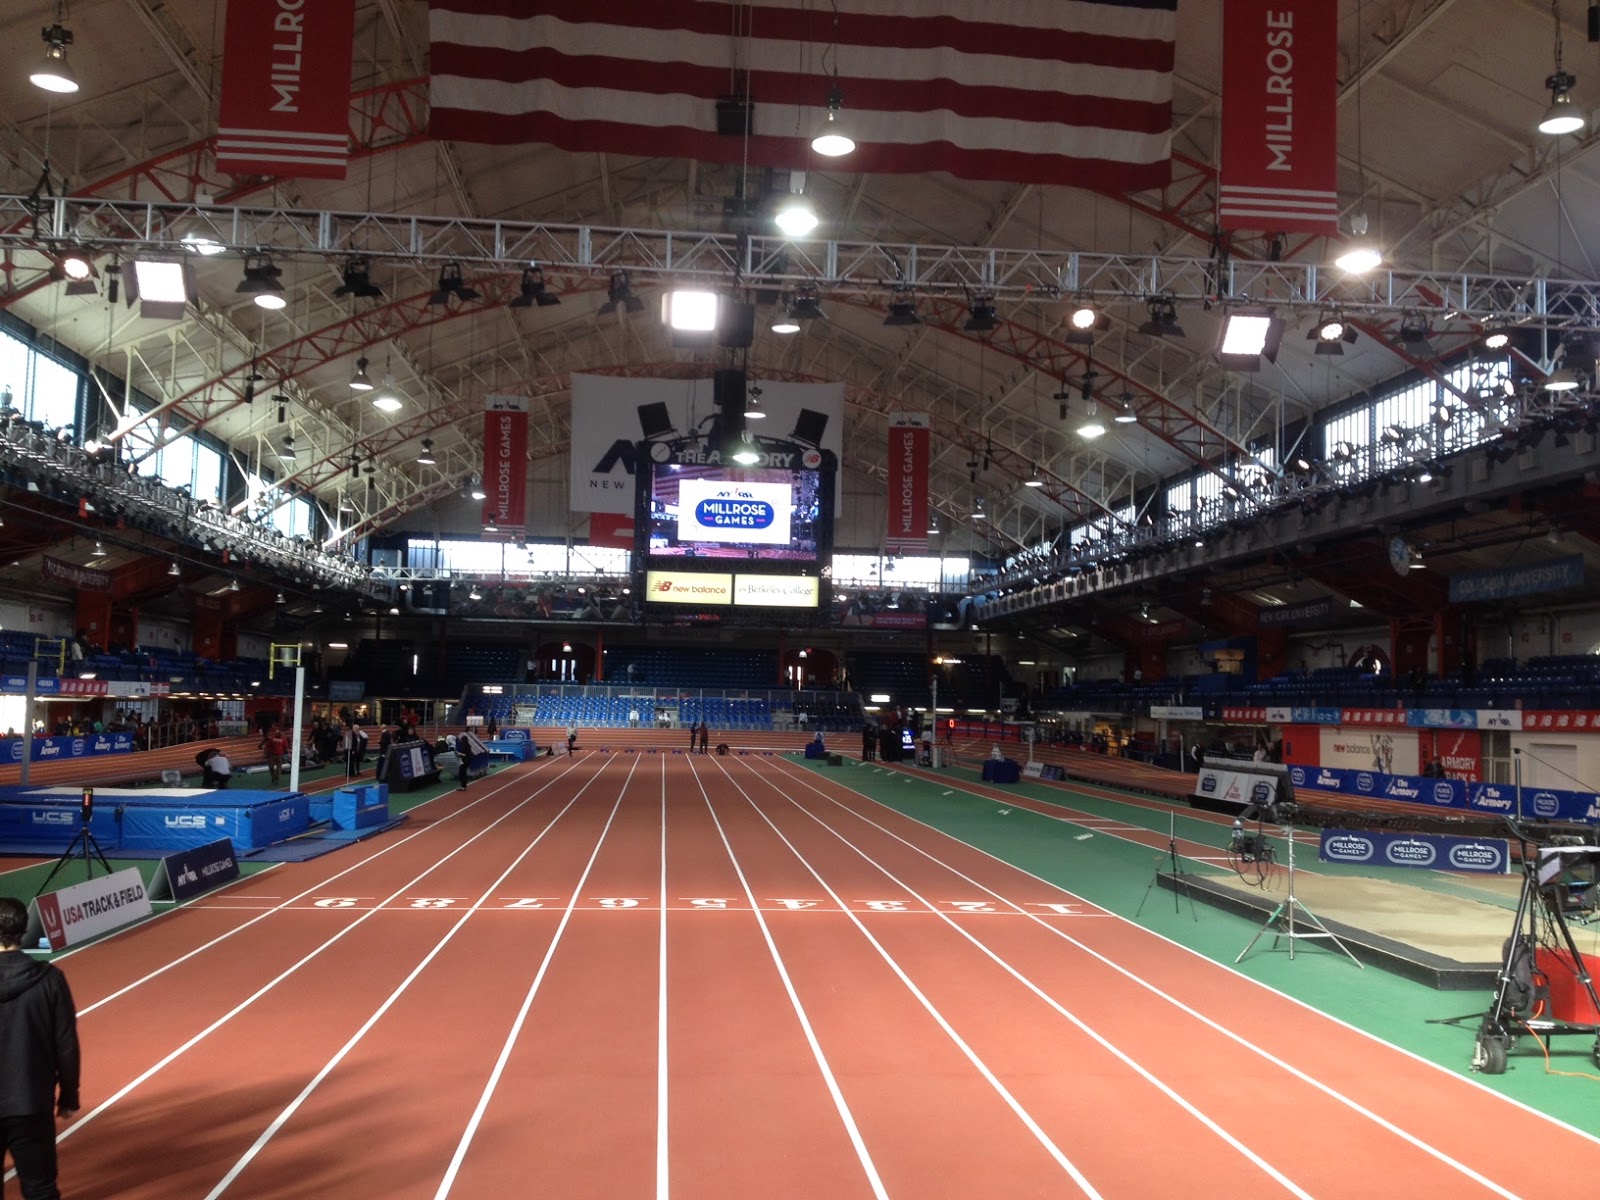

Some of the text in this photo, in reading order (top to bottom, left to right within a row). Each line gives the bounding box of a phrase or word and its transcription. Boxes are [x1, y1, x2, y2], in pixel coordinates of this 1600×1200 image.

[1265, 10, 1294, 172] MILLROSE
[676, 449, 795, 467] THE AORY
[498, 415, 512, 519] MILLROSE GAMES
[589, 479, 625, 490] NEW
[902, 432, 914, 533] MILLROSE GAMES
[703, 502, 767, 516] MILLROSE
[715, 515, 755, 526] GAMES
[1508, 563, 1569, 587] UNIVERSITY
[673, 585, 690, 593] new
[692, 584, 727, 594] balance
[1333, 743, 1371, 754] new balance
[1441, 755, 1476, 771] ARMORY
[1322, 769, 1331, 778] The
[1316, 775, 1341, 789] Armory
[1396, 778, 1409, 787] The
[1389, 786, 1419, 798] Armory
[1486, 787, 1501, 798] The
[1477, 795, 1512, 811] Armory
[32, 811, 74, 822] UCS
[164, 815, 206, 826] UCS
[1332, 842, 1366, 851] MILLROSE
[1393, 846, 1429, 855] MILLROSE
[1457, 849, 1493, 859] MILLROSE
[62, 884, 144, 925] USA TRACK & FIELD
[409, 898, 456, 908] 8
